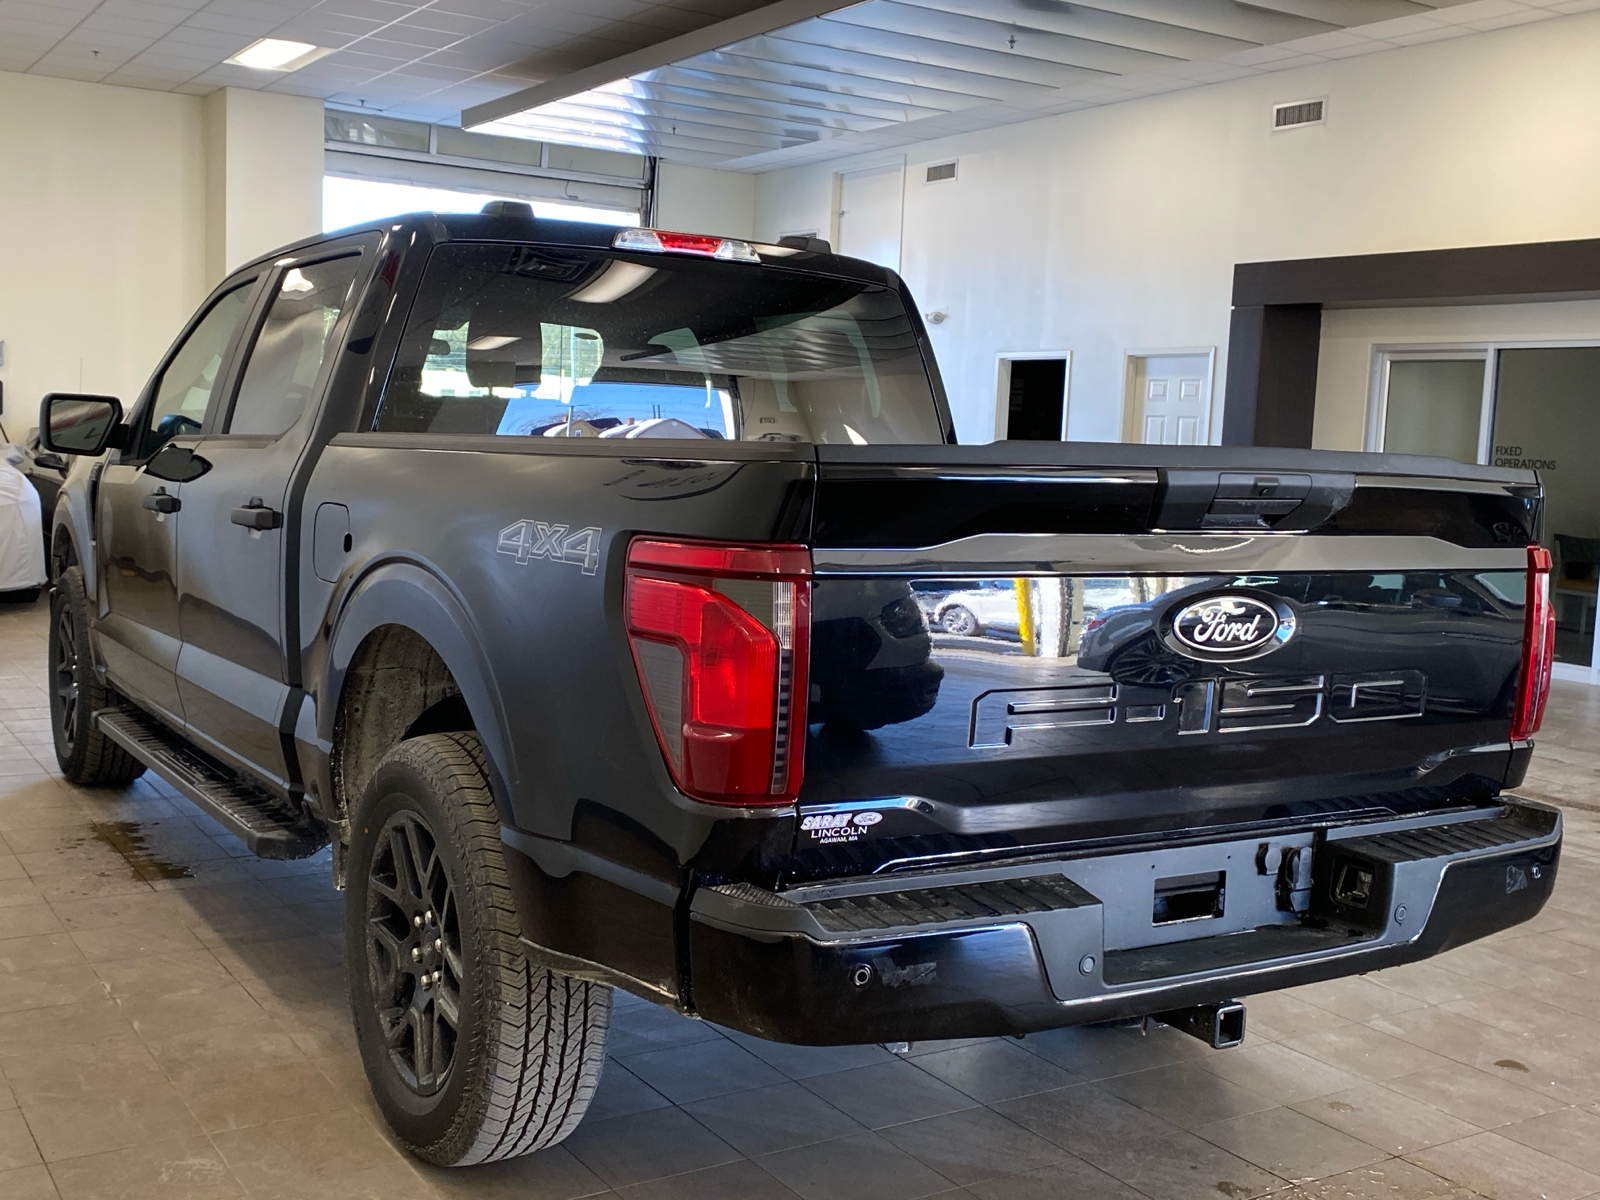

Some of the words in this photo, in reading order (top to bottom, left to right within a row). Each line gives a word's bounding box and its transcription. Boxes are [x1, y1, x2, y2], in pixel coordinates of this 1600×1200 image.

[1495, 445, 1523, 456] FIXED
[1494, 457, 1557, 470] OPERATIONS
[1193, 604, 1262, 643] Ford
[968, 669, 1428, 749] F-150
[800, 813, 853, 831] SARAT
[811, 825, 868, 839] LINCOLN
[819, 835, 848, 844] AGAWAM,
